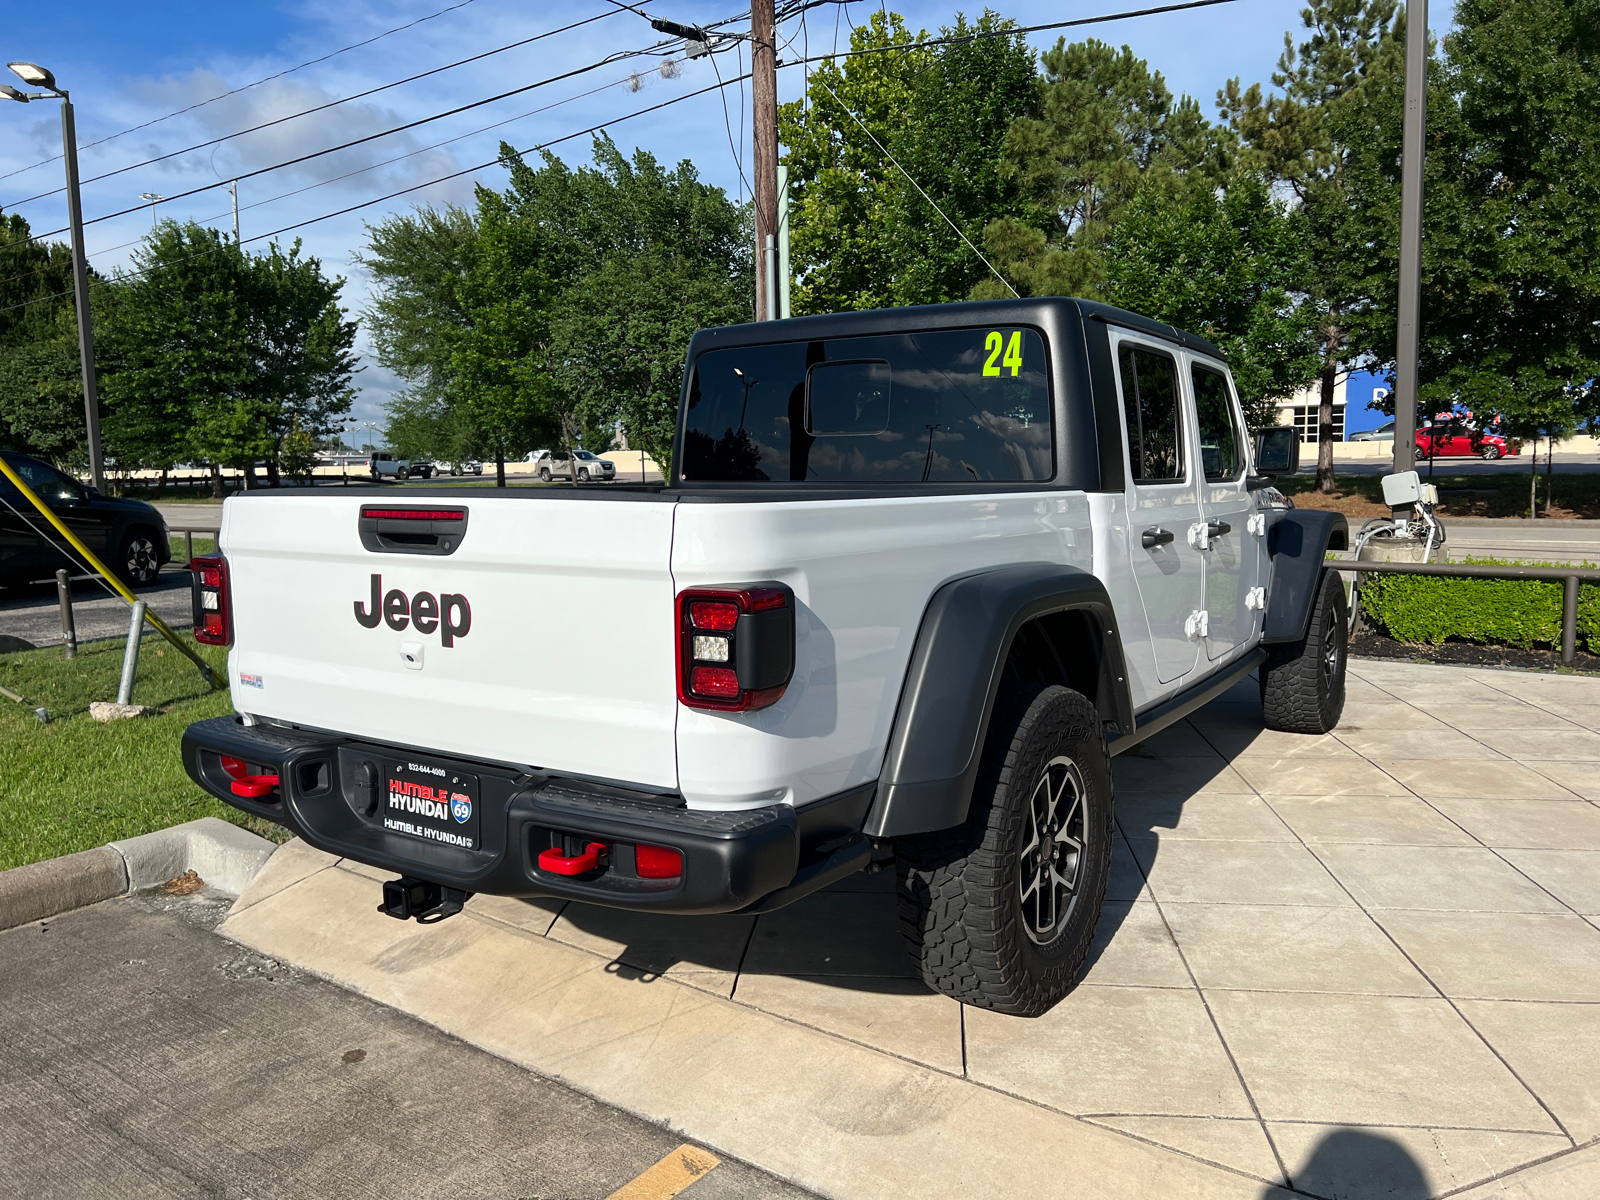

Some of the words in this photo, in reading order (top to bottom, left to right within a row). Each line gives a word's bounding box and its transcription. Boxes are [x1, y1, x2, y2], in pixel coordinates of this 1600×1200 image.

[983, 331, 1022, 376] 24
[353, 573, 471, 648] Jeep
[408, 763, 446, 777] 832-644-4000
[389, 779, 448, 803] HUMBLE
[389, 792, 448, 820] HYUNDAI
[454, 803, 469, 818] 69
[384, 818, 423, 836] HUMBLE
[424, 827, 466, 847] HYUNDAI
